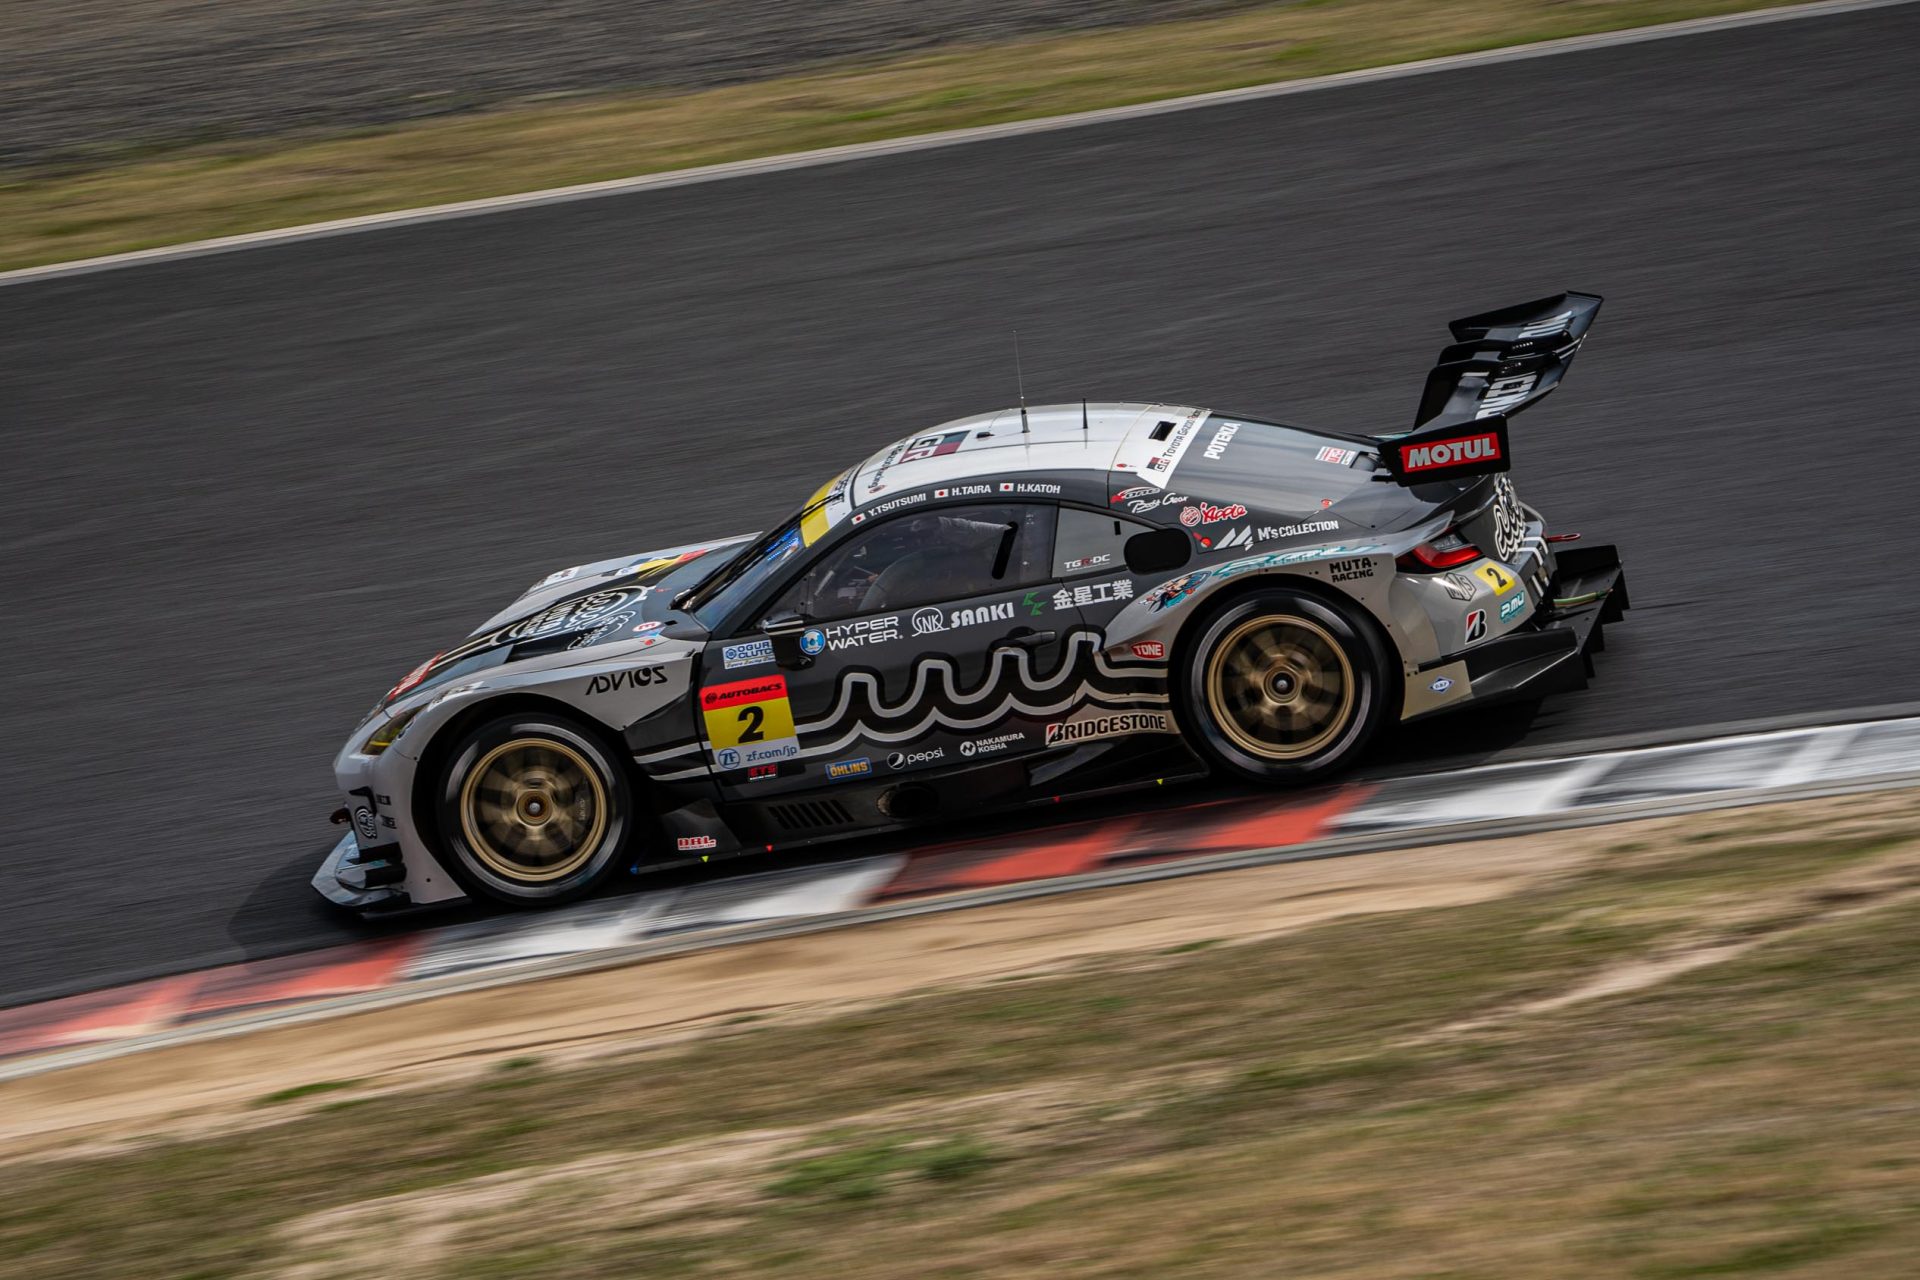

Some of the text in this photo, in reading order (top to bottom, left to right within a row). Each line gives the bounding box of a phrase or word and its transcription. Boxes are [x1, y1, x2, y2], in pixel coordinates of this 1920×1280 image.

[1162, 436, 1184, 457] TOYOTA
[1203, 422, 1242, 460] POTENZA
[1408, 437, 1496, 468] MOTUL
[952, 484, 991, 496] H.TAIRA
[1017, 483, 1060, 494] H.KATOH
[868, 493, 926, 517] Y.TSUTSUMI
[1279, 520, 1339, 538] COLLECTION
[1064, 554, 1110, 568] TGR-DC
[1329, 557, 1372, 574] MUTA
[1332, 569, 1374, 583] RACING
[1486, 568, 1507, 588] 2
[1053, 579, 1134, 610] 金星工業
[951, 602, 1015, 628] SANKI
[826, 616, 899, 638] HYPER
[737, 641, 770, 653] OGUR
[738, 648, 772, 659] CLUTC
[1133, 643, 1162, 656] TONE
[718, 683, 782, 699] AUTOBACS
[737, 706, 764, 744] 2
[1046, 714, 1166, 745] BRIDGESTONE
[976, 732, 1025, 747] NAKAMURA
[978, 743, 1007, 753] KOSHA
[719, 745, 797, 768] ZF zf.com/jp
[906, 747, 945, 765] pepsi
[829, 760, 868, 777] ÖHLINS
